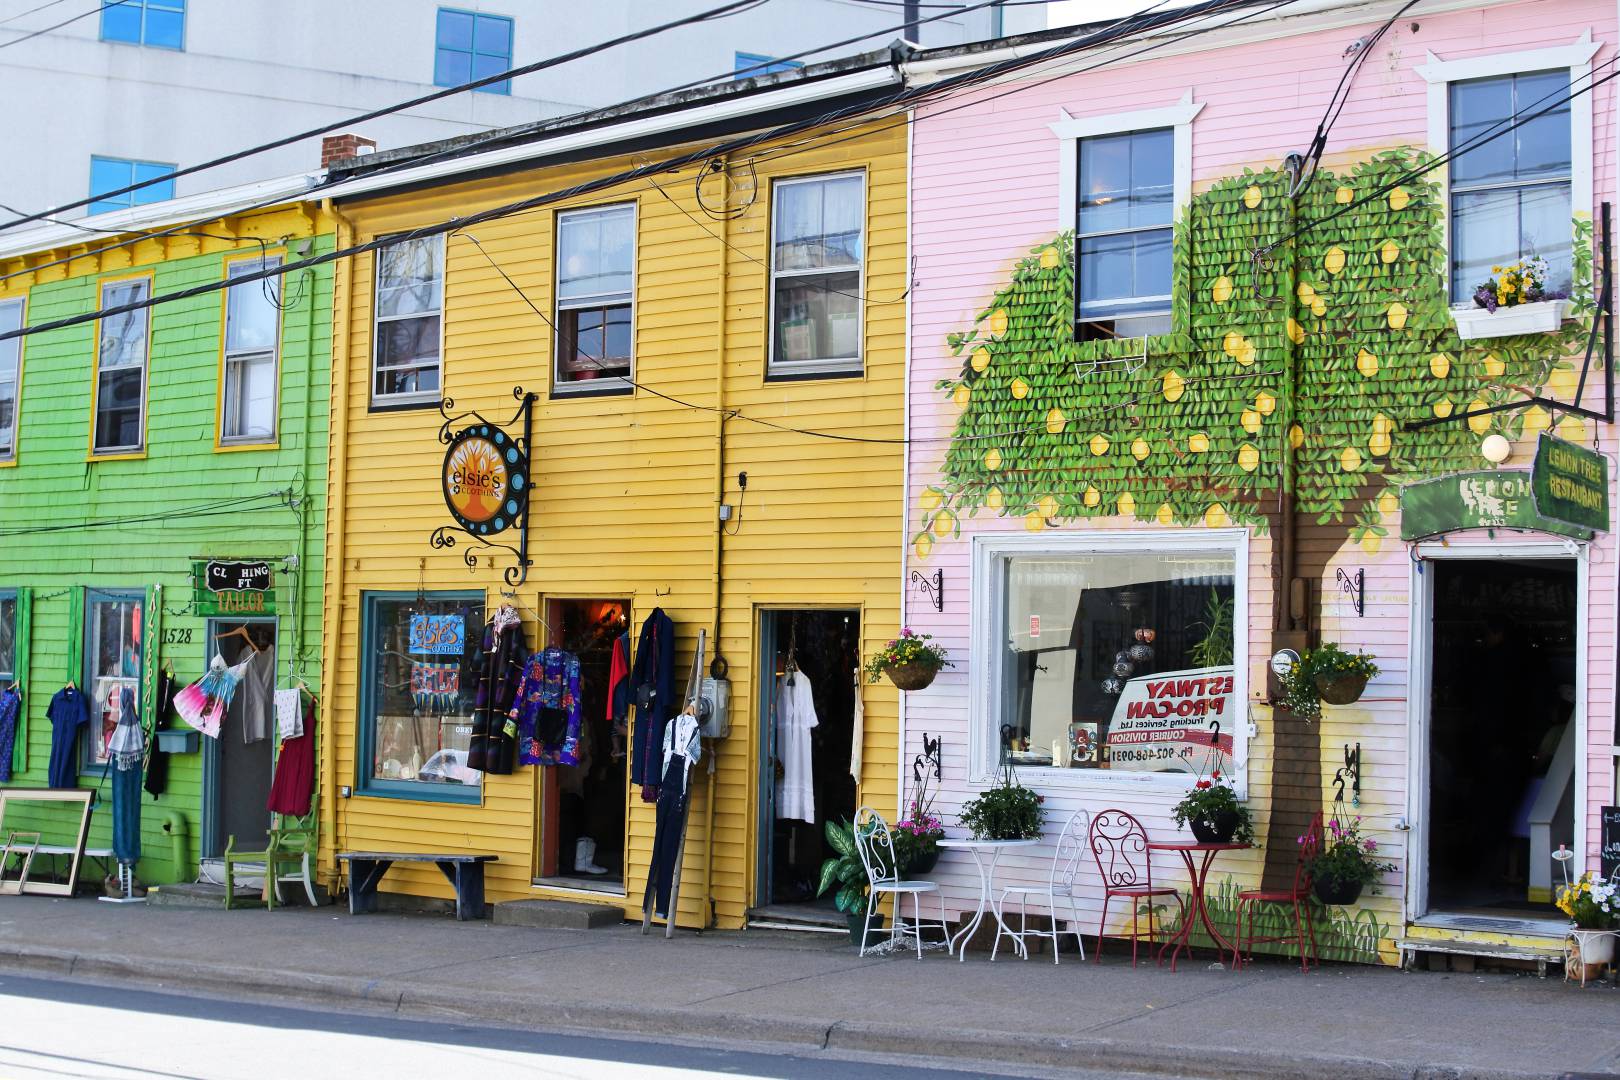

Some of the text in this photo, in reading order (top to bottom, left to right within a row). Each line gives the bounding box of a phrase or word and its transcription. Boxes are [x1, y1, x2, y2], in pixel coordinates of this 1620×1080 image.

[453, 466, 500, 489] elsie's
[1548, 448, 1601, 484] LEMON TREE
[1549, 473, 1602, 511] RESTAURANT
[216, 591, 264, 612] TAILOR
[163, 628, 193, 644] 1528
